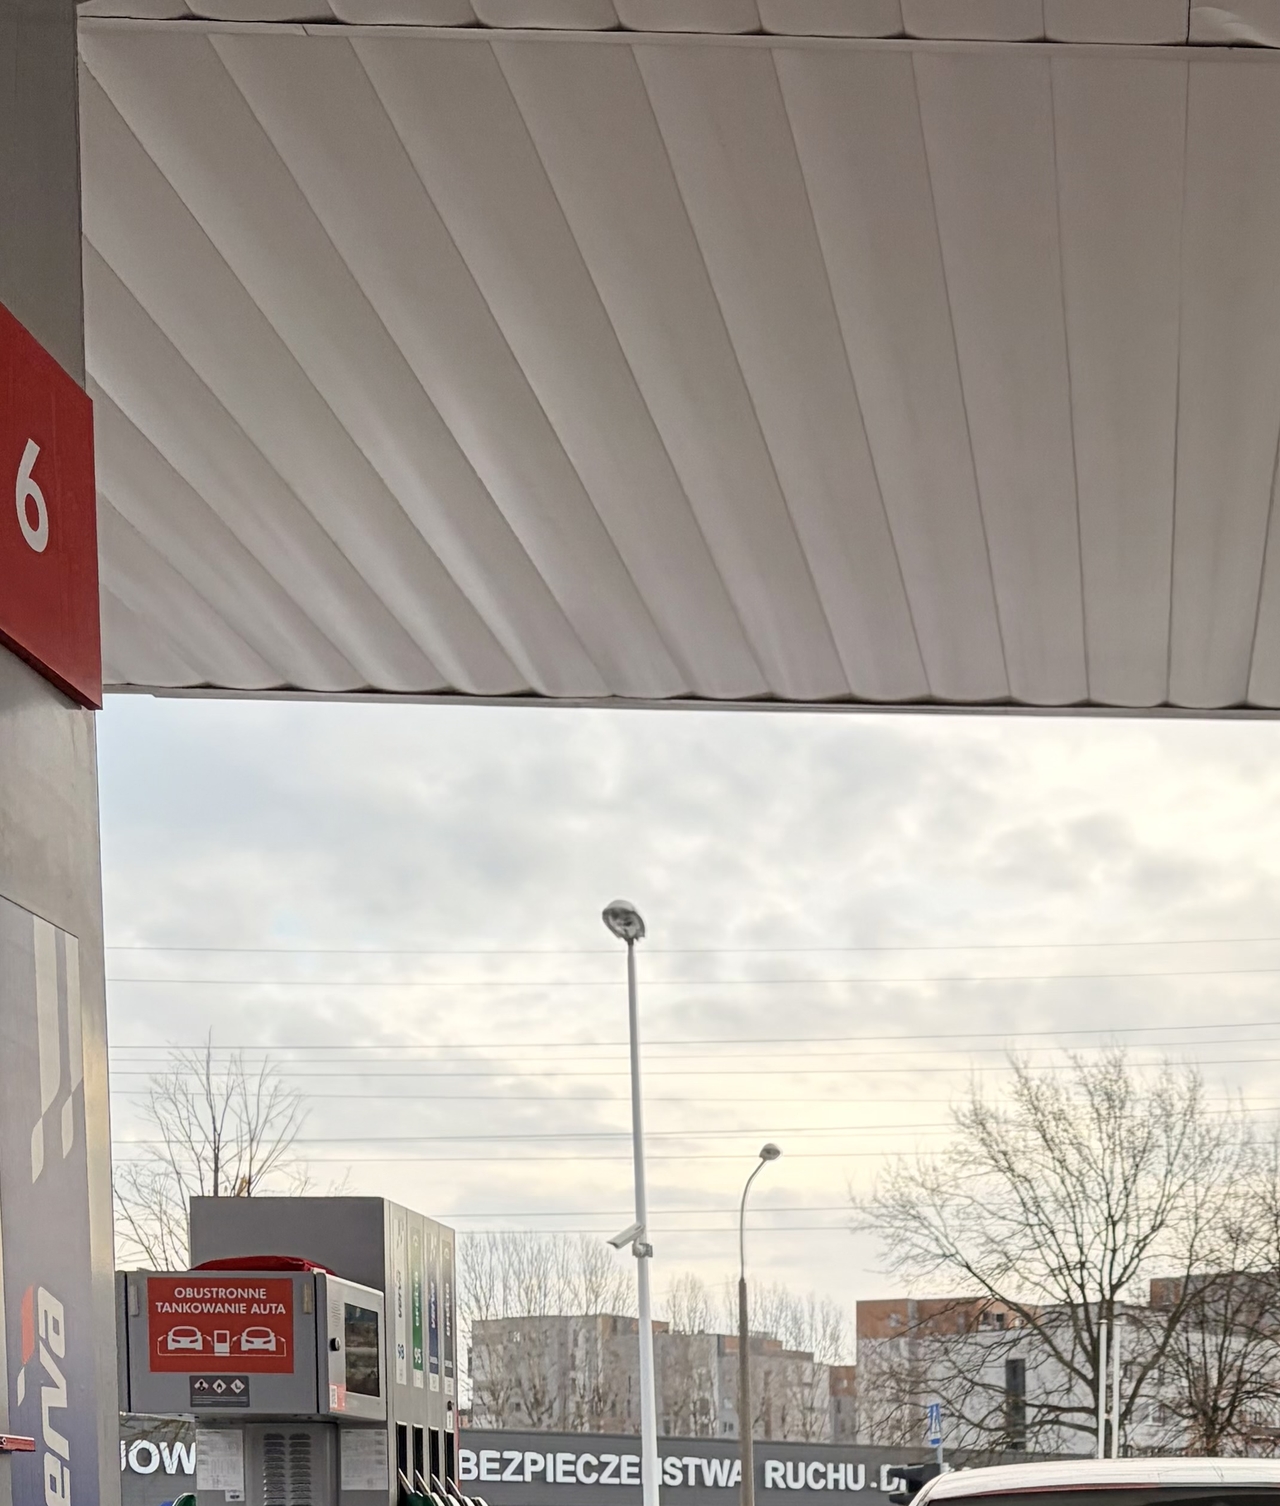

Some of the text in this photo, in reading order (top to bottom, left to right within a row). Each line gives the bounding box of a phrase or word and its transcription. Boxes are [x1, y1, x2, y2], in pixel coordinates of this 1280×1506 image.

[15, 438, 49, 553] 6
[174, 1287, 267, 1299] OBUSTRONNE
[156, 1302, 286, 1315] TANKOWANIE AUTA
[765, 1459, 866, 1491] RUCHU
